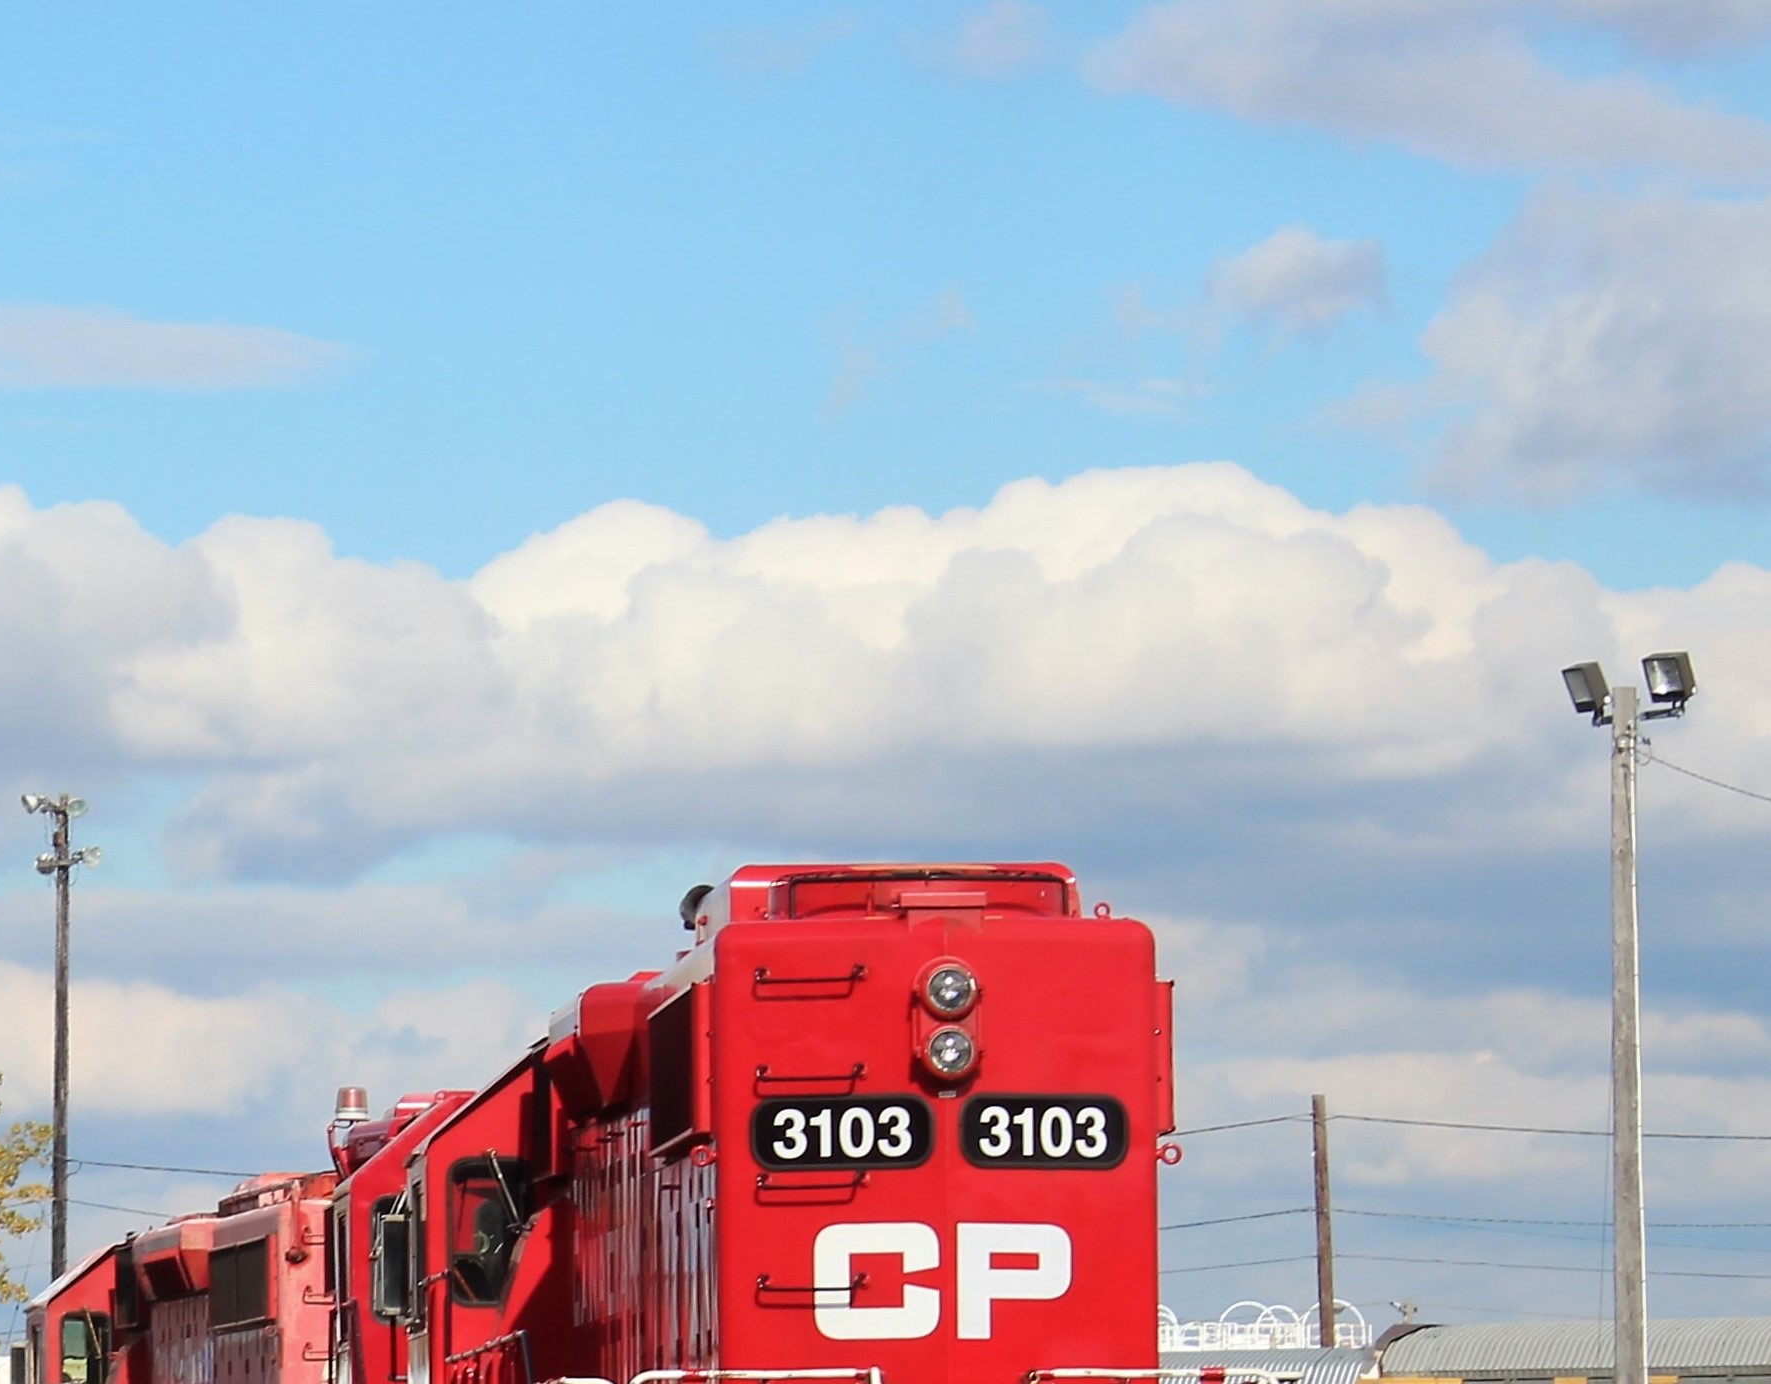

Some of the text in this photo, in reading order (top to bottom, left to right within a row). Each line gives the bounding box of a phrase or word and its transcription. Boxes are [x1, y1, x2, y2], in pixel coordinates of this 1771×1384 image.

[772, 1106, 913, 1160] 3103
[978, 1106, 1108, 1159] 3103
[813, 1222, 1072, 1340] CP
